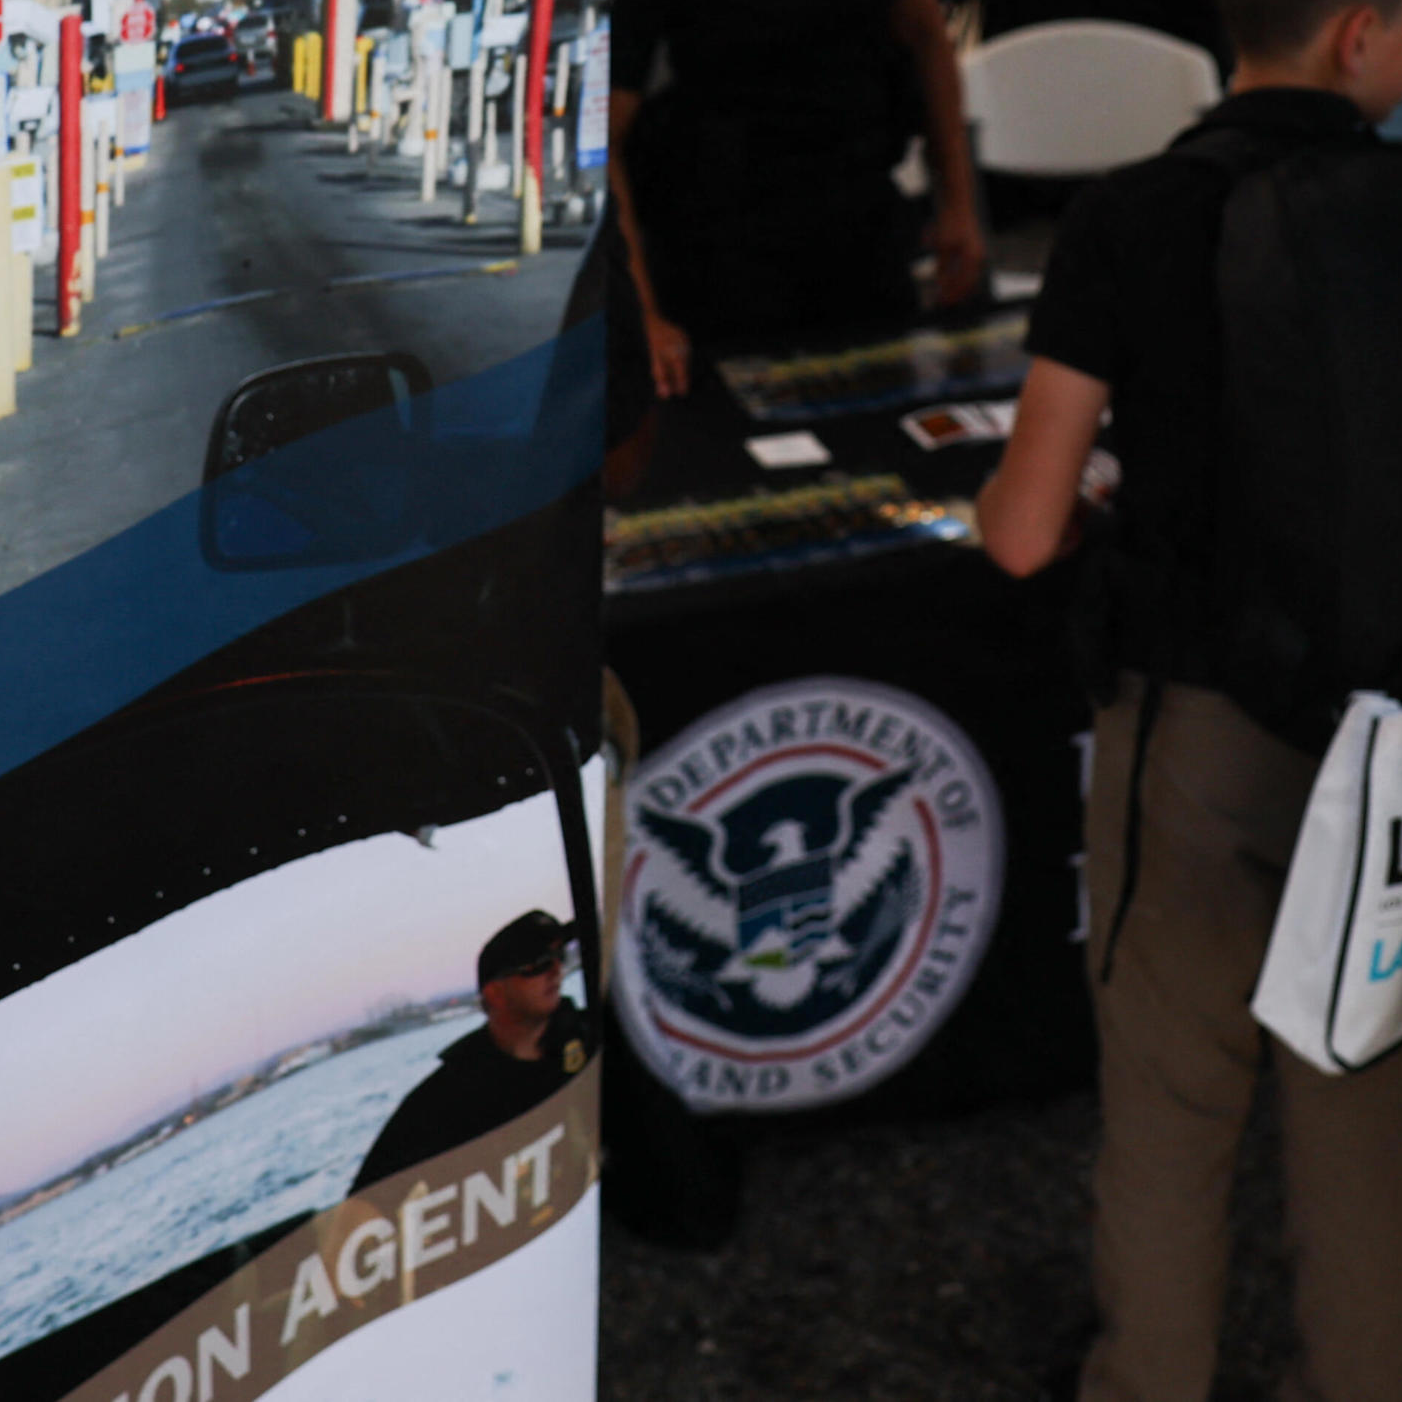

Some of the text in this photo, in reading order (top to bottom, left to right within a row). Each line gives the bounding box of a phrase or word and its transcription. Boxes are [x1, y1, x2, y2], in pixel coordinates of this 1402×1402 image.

[648, 700, 981, 833] DEPARTMENT OF
[811, 884, 978, 1084] SECURITY
[281, 1124, 565, 1345] AGENT
